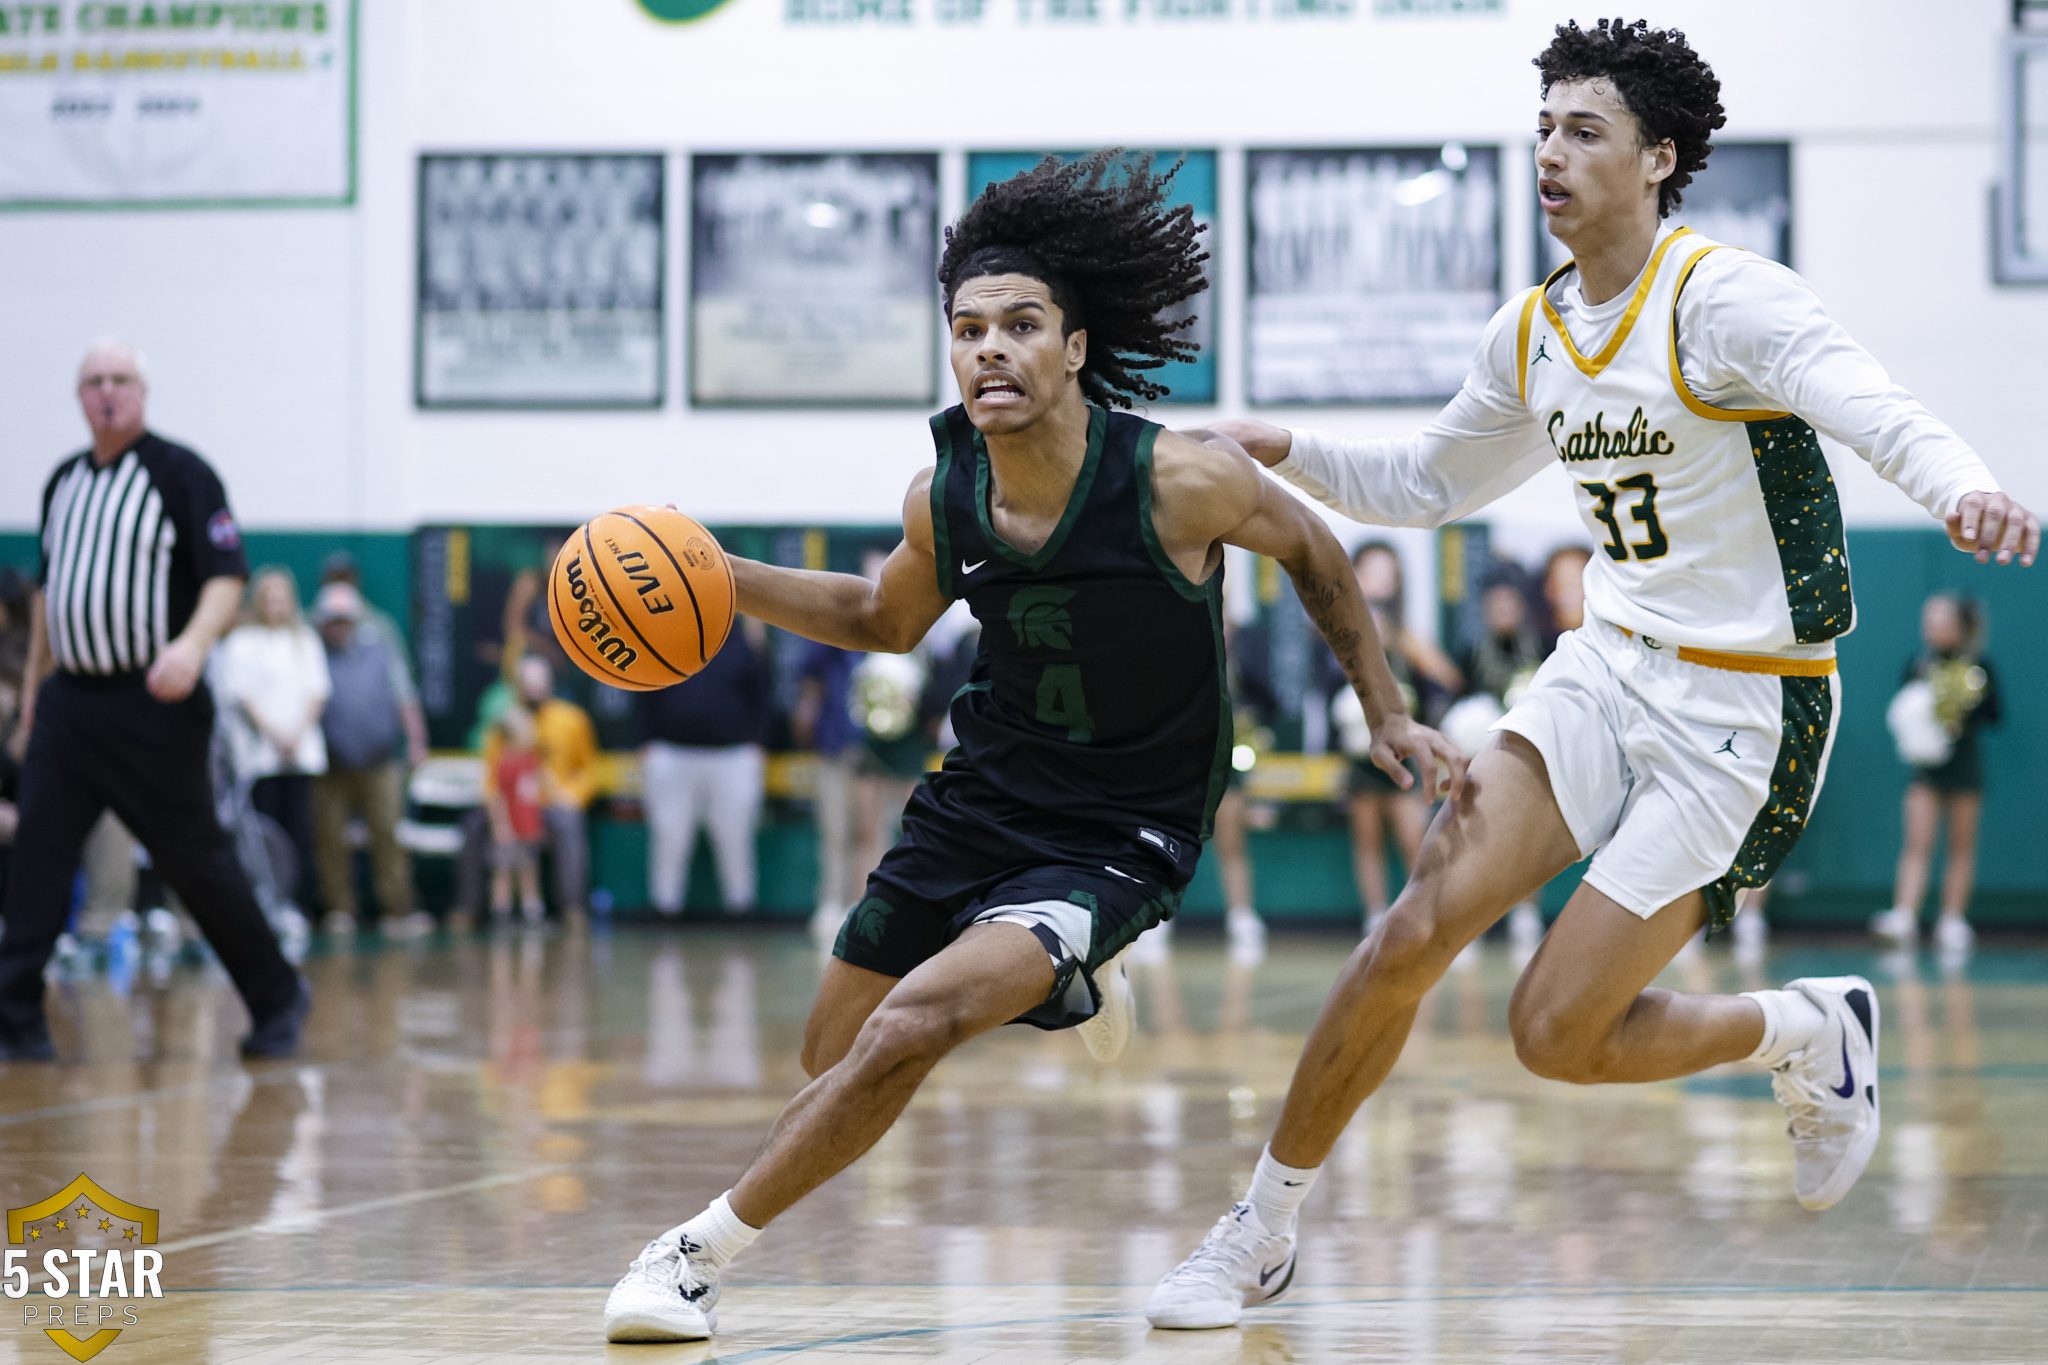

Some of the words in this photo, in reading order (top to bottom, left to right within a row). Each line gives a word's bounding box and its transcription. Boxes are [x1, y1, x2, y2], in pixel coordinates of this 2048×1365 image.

[77, 2, 328, 34] CHAMPIONS
[72, 49, 304, 72] BASKETBALL
[1547, 405, 1675, 463] Catholic
[1579, 472, 1670, 563] 33
[565, 555, 638, 673] Wilson
[1035, 664, 1096, 743] 4
